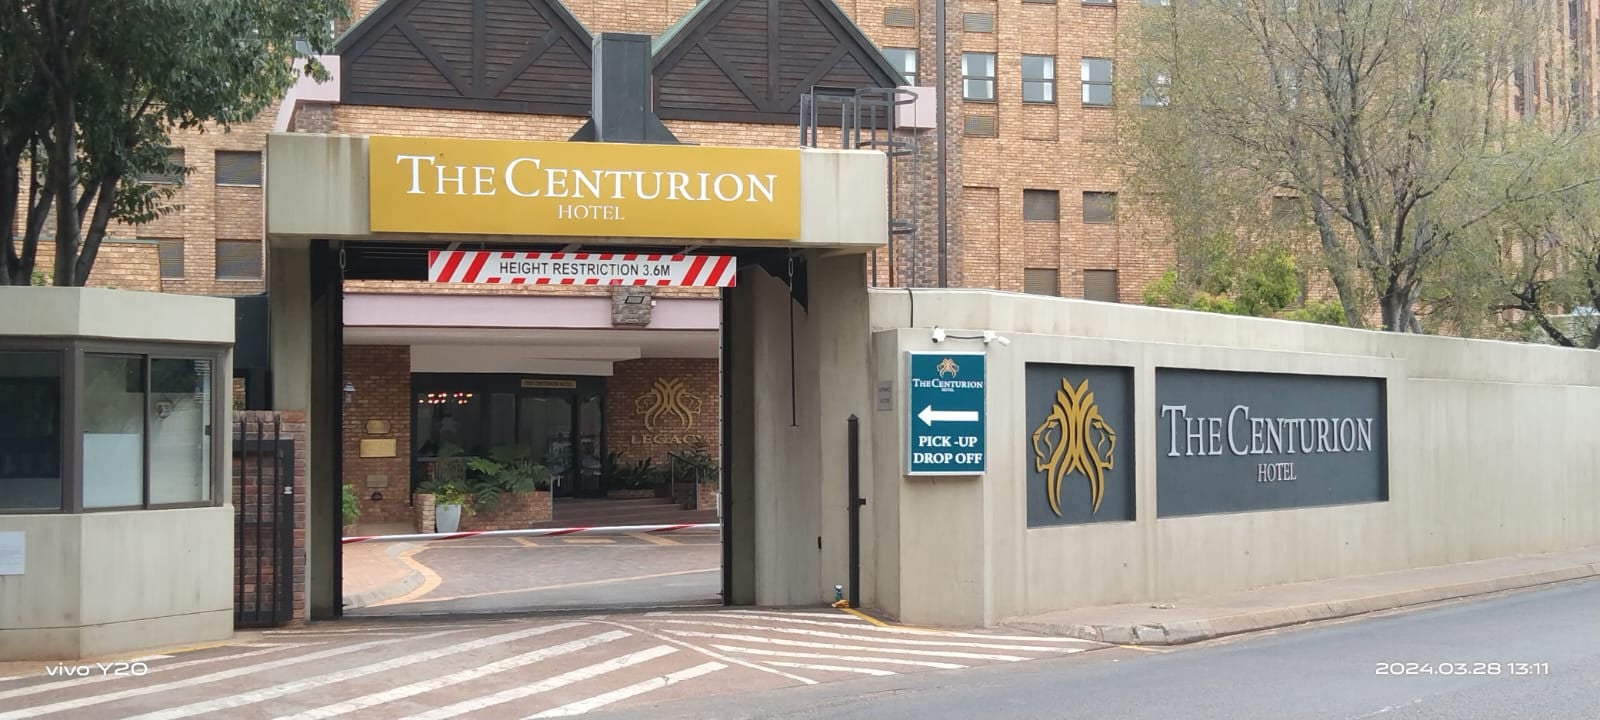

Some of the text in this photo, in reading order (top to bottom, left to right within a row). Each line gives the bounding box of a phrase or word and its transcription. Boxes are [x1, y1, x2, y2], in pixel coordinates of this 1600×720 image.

[396, 154, 778, 203] THE CENTURION
[557, 204, 625, 221] HOTEL
[500, 261, 671, 277] HEIGHT RESTRICTION 3.6M
[912, 378, 983, 389] THE CENTURION
[1161, 404, 1374, 457] THE CENTURION
[918, 435, 952, 447] PICK
[912, 452, 983, 464] DROP OFF
[1257, 462, 1297, 482] HOTEL
